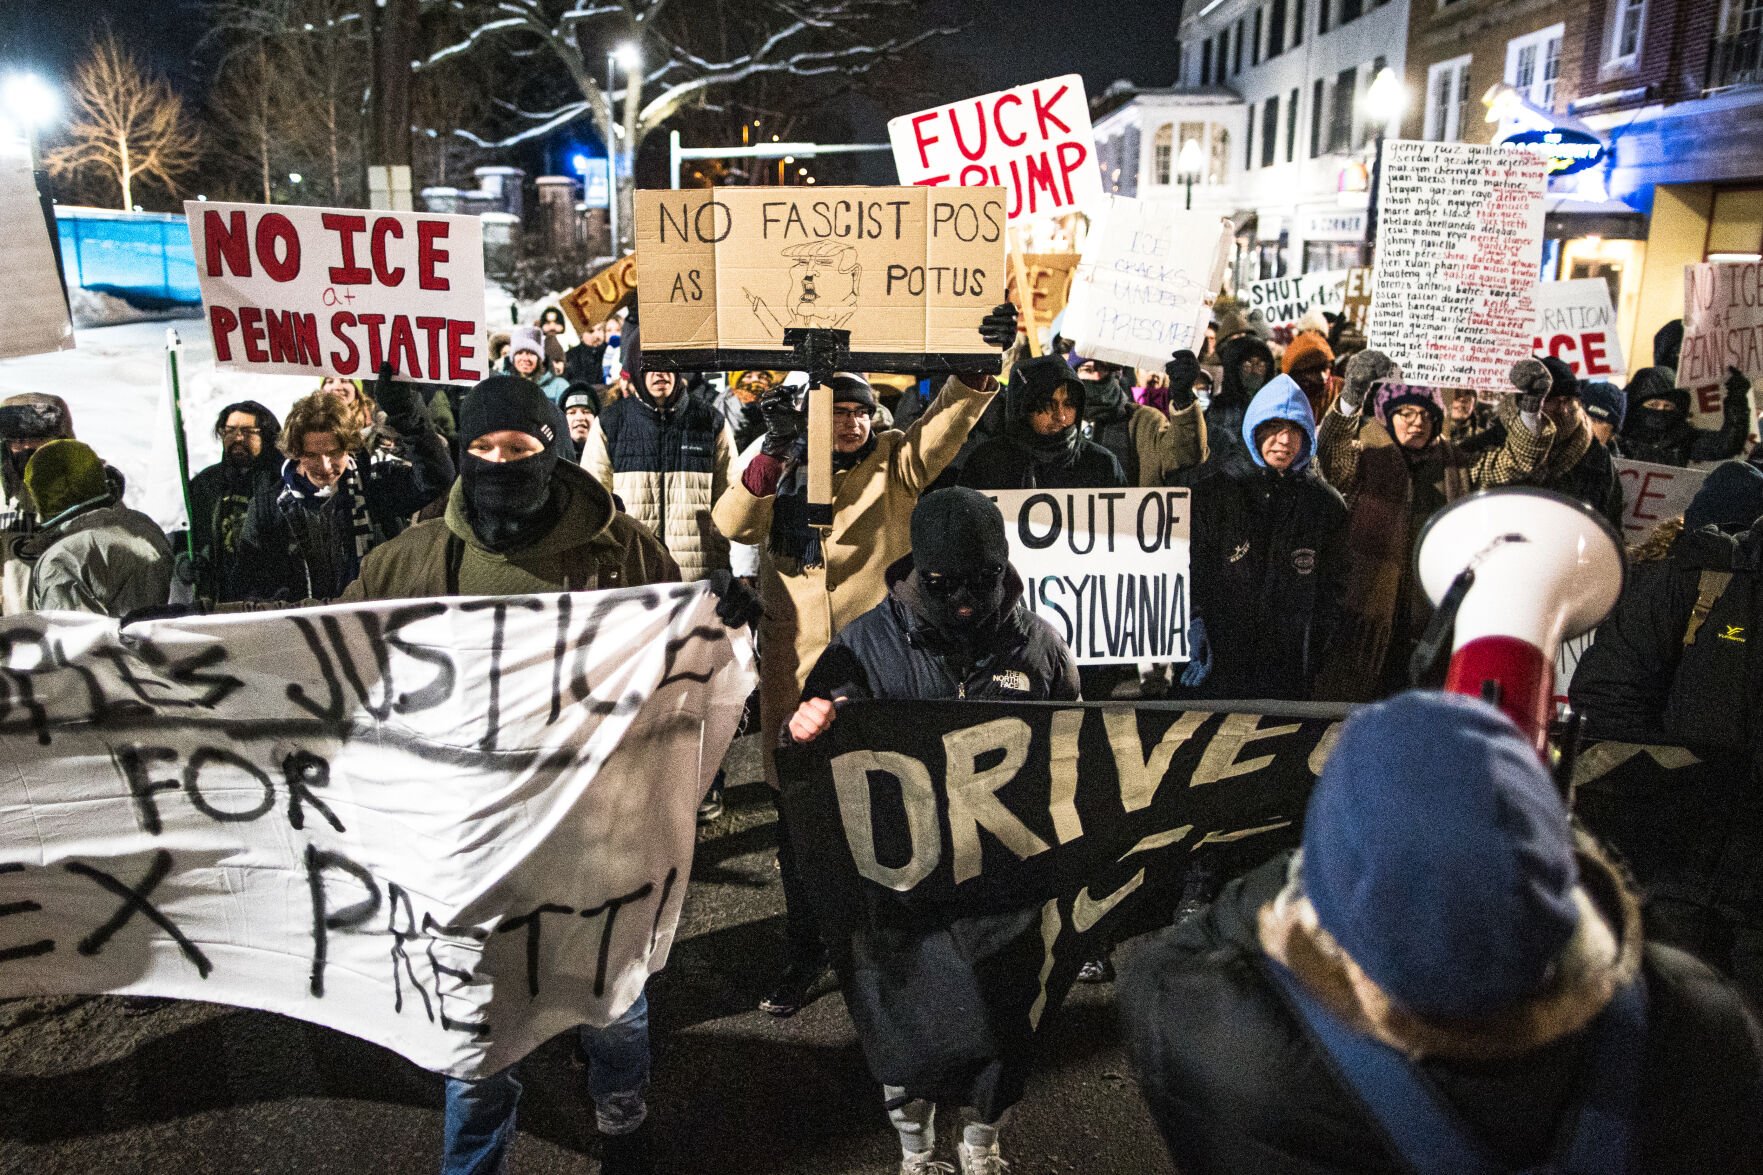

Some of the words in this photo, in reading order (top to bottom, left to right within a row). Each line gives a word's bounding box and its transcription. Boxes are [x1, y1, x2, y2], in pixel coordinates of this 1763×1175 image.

[911, 85, 1072, 168] FUCK
[1434, 145, 1463, 155] ruiz
[659, 201, 732, 243] NO
[763, 200, 910, 240] FASCIST
[933, 202, 1001, 243] POS
[205, 211, 300, 282] NO
[322, 213, 450, 291] ICE
[322, 286, 356, 307] at
[569, 263, 638, 326] FUC
[671, 270, 703, 303] AS
[887, 264, 986, 297] POTUS
[1251, 277, 1303, 304] SHUT
[1265, 302, 1309, 323] OWN
[209, 305, 323, 367] PENN
[329, 311, 481, 381] STATE
[1727, 324, 1763, 372] STAT
[1018, 492, 1125, 554] OUT
[1137, 491, 1188, 553] OF
[1019, 573, 1187, 657] SYLVANIA
[286, 587, 728, 750] JUSTICE
[992, 674, 1020, 683] NORTH
[1000, 681, 1020, 690] FACE
[113, 742, 346, 834] FOR
[830, 707, 1303, 892] DRIVE
